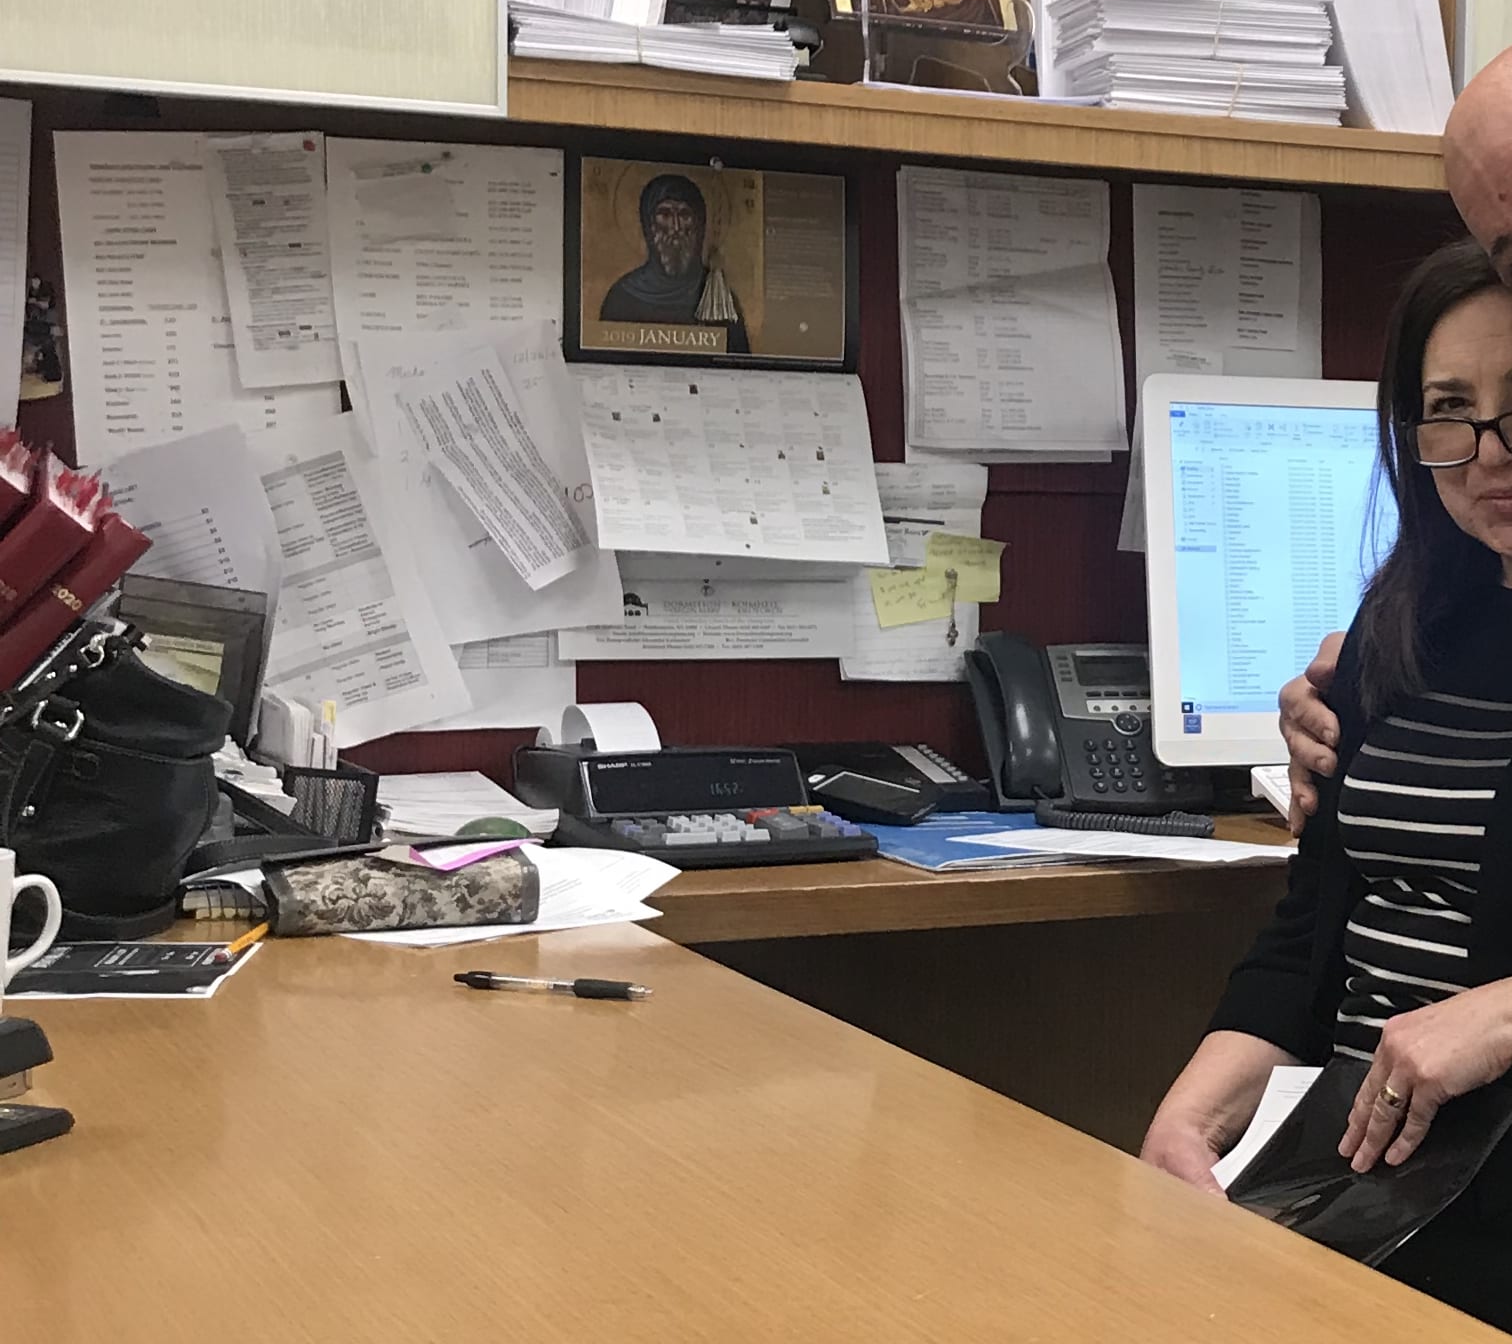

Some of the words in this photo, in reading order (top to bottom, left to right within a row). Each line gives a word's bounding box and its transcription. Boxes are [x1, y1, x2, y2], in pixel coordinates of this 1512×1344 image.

[601, 329, 636, 343] 2019
[639, 327, 721, 347] JANUARY
[51, 582, 83, 611] 2020
[597, 761, 628, 770] SHARP
